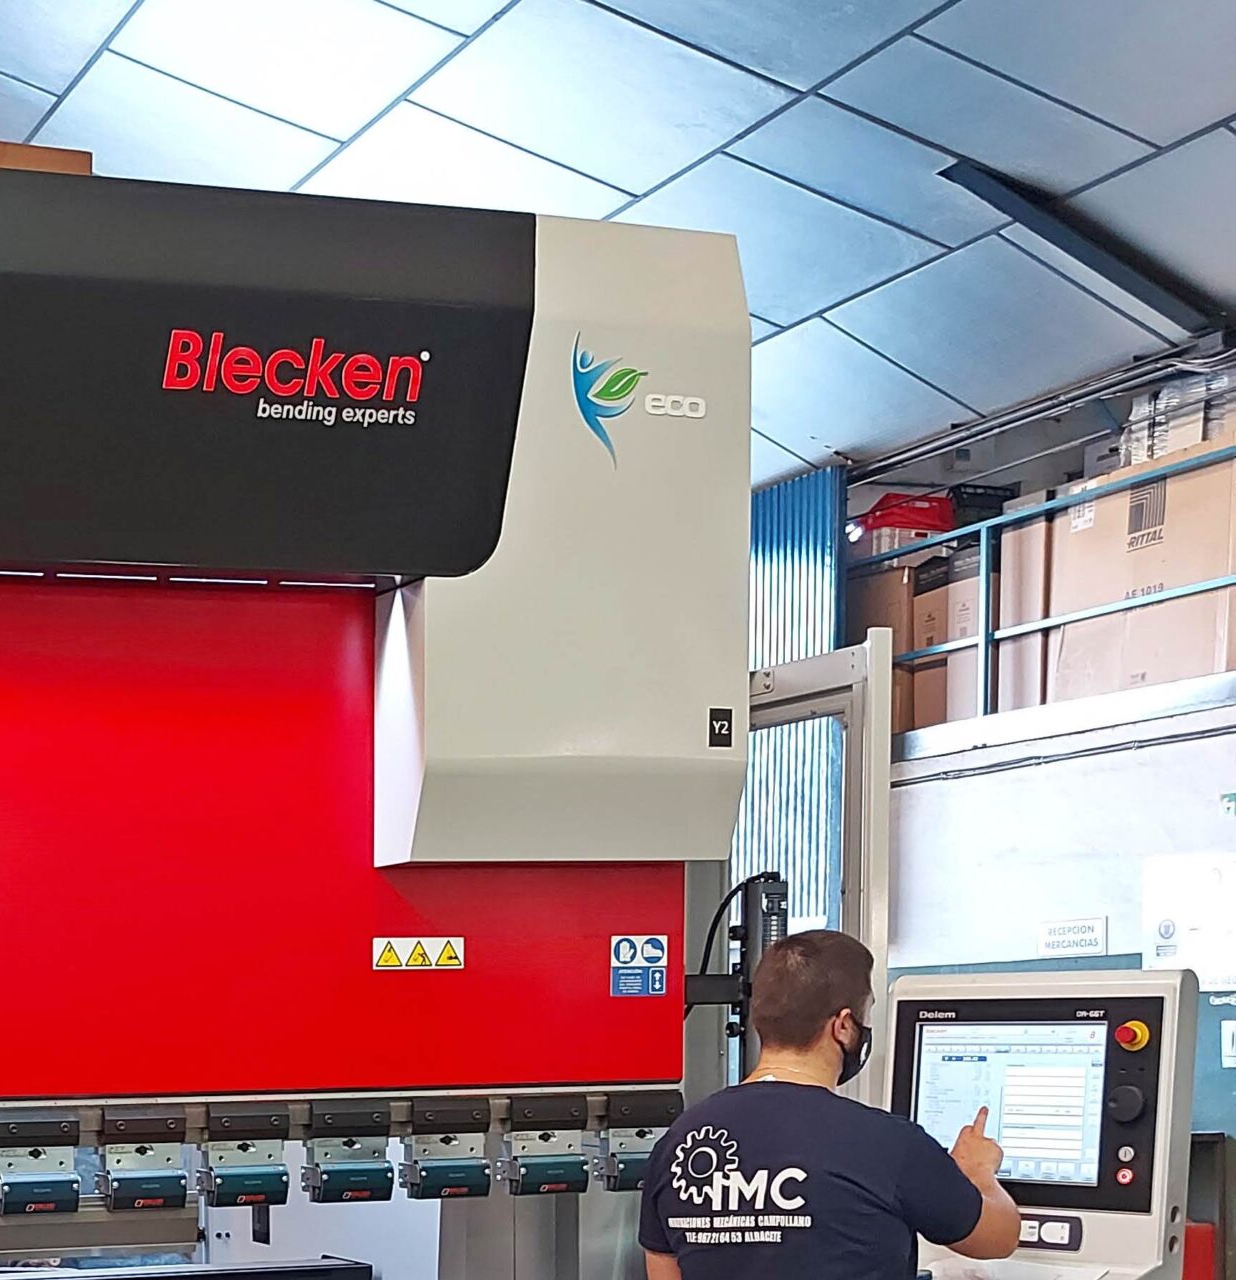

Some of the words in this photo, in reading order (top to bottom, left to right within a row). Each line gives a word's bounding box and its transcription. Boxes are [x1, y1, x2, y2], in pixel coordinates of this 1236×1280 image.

[162, 329, 423, 402] Blecken
[256, 398, 338, 427] bending
[341, 404, 417, 428] experts
[644, 393, 707, 419] eco
[1126, 527, 1165, 550] RITTAL
[712, 720, 730, 735] Y2
[918, 1010, 957, 1019] Delem
